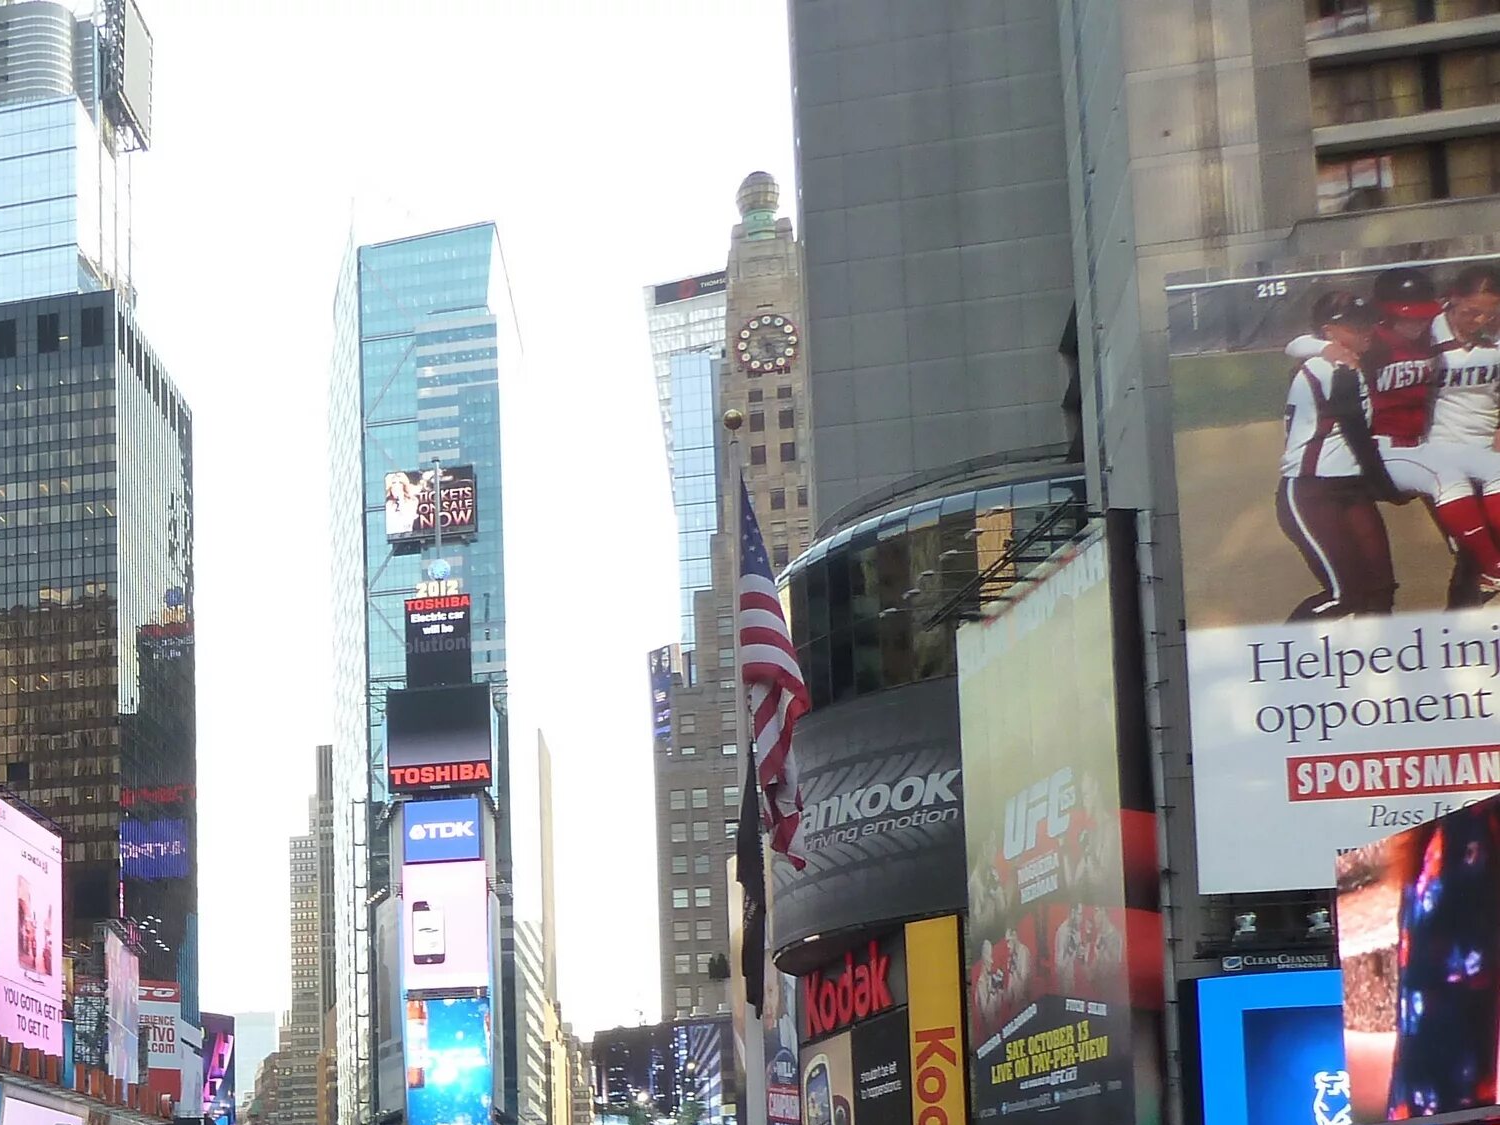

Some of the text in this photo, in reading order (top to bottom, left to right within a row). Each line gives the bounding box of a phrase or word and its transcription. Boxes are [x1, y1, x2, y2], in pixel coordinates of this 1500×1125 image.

[1257, 281, 1287, 298] 215
[442, 499, 473, 512] SALE
[420, 510, 472, 528] NOW
[416, 581, 459, 597] 2012
[406, 596, 470, 611] TOSHIBA
[411, 611, 465, 622] Electric car
[1248, 628, 1428, 689] Helped
[1255, 688, 1493, 743] opponent
[390, 762, 490, 785] TOSHIBA
[1368, 804, 1423, 827] Pass
[424, 821, 475, 839] TDK
[805, 807, 959, 851] driving emotion
[803, 939, 894, 1038] Kodak
[3, 985, 20, 1011] YOU
[20, 992, 43, 1017] GOTTA
[43, 1004, 57, 1024] GET
[16, 1014, 27, 1032] TO
[27, 1019, 43, 1037] GET
[1028, 1025, 1074, 1055] OCTOBER
[991, 1062, 1013, 1084] LIVE
[1014, 1056, 1030, 1078] ON
[1031, 1035, 1108, 1075] PAY-PER-VIEW
